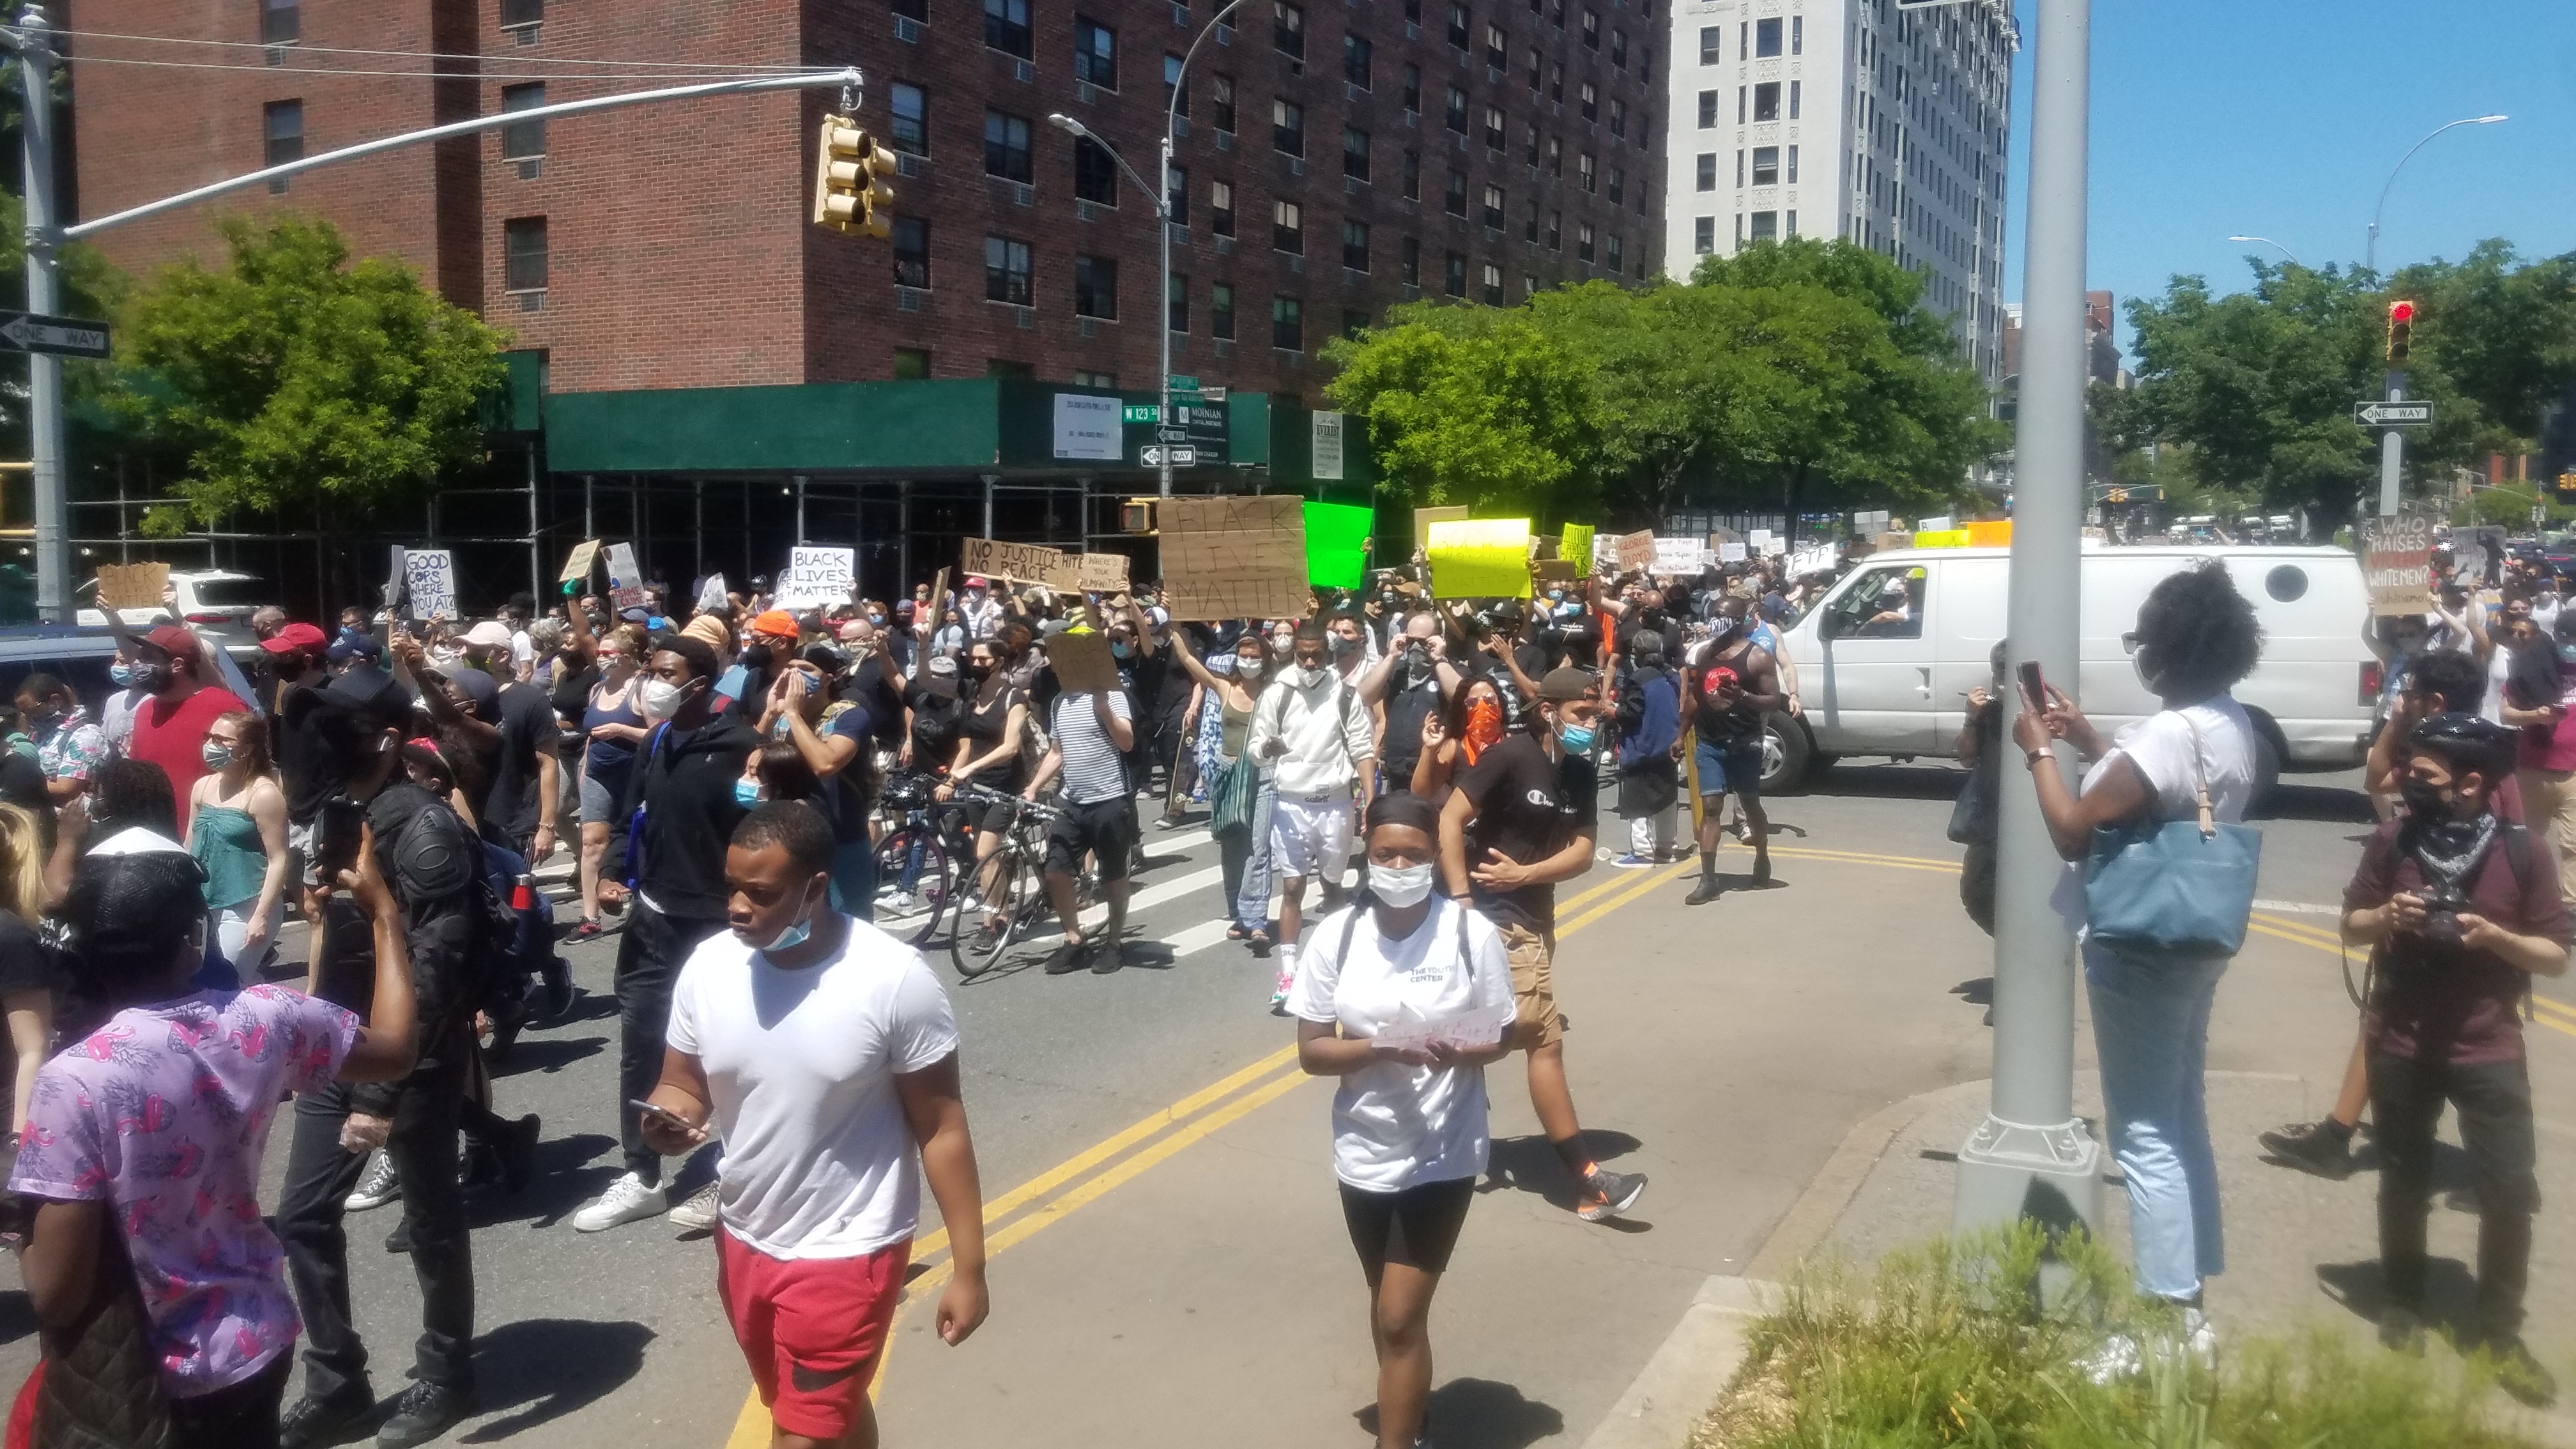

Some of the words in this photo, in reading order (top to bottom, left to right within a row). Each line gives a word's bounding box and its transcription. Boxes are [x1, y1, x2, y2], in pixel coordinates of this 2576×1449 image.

[12, 325, 45, 341] ONE
[64, 328, 100, 347] WAY
[1126, 408, 1133, 420] W
[1136, 408, 1149, 420] 123
[1192, 408, 1222, 419] MOINIAN
[2367, 410, 2388, 418] ONE
[2398, 409, 2422, 418] WAY
[1173, 432, 1184, 441] WAY
[1149, 452, 1160, 460] ON
[1173, 452, 1190, 460] WAY
[1176, 501, 1296, 542] BLACK
[2380, 516, 2426, 535] WHO
[1619, 535, 1650, 551] GEORGE
[2372, 533, 2426, 553] RAISES
[406, 553, 448, 571] GOOD
[795, 551, 847, 567] BLACK
[971, 542, 992, 558] NO
[1000, 545, 1061, 570] JUSTICE
[1089, 556, 1119, 567] WHERE'S
[1184, 540, 1296, 574] LIVES
[1623, 549, 1651, 566] FLOYD
[1791, 546, 1828, 571] FTP
[104, 567, 157, 585] BLACK
[795, 569, 848, 583] LIVES
[970, 560, 989, 572] NO
[1000, 561, 1046, 581] PEACE
[1093, 567, 1110, 576] YOUR
[411, 583, 445, 597] WHERE
[793, 585, 849, 596] MATTER
[1176, 576, 1307, 614] MATTER
[411, 596, 432, 612] YOU
[433, 594, 457, 611] AT?
[1411, 967, 1426, 976] THE
[1427, 965, 1456, 974] YOUTH
